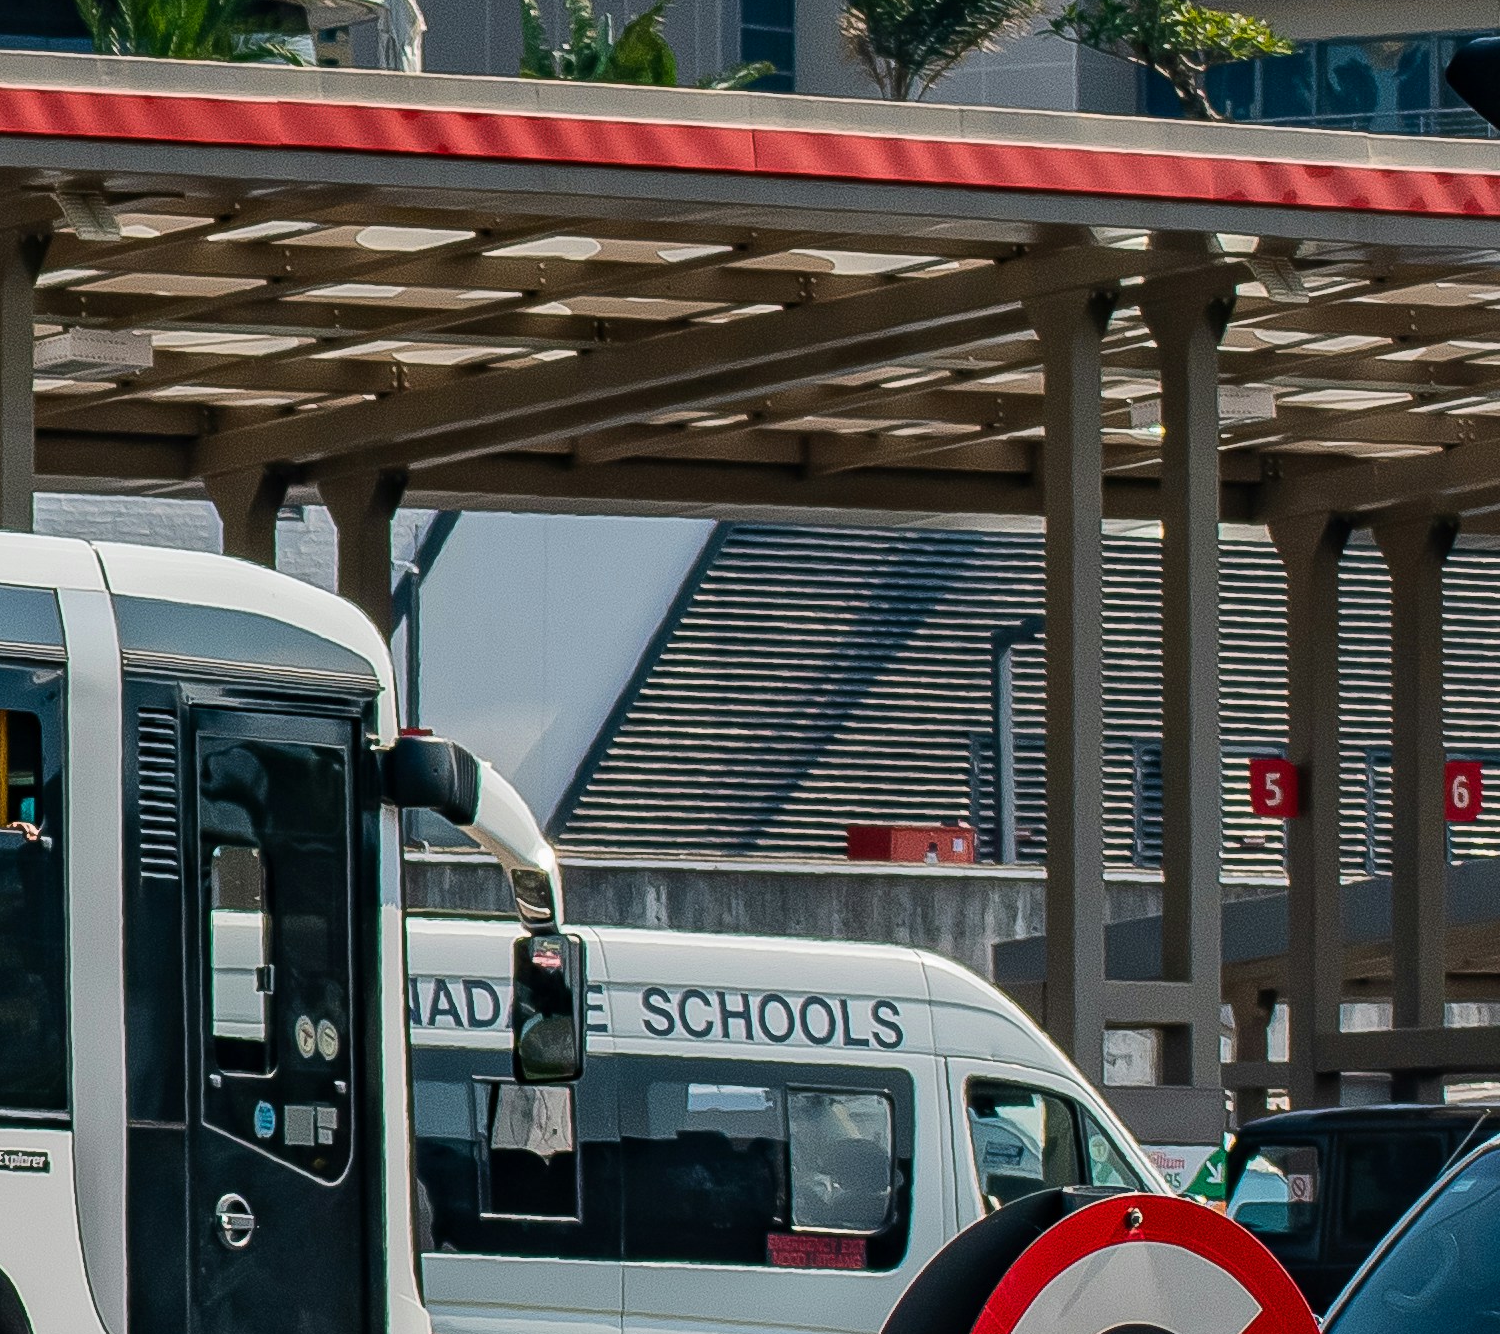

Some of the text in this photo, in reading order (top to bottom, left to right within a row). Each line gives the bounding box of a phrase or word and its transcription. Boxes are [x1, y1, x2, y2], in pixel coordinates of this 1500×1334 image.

[1264, 772, 1284, 807] 5
[1452, 775, 1471, 809] 6
[641, 986, 904, 1049] SCHOOLS
